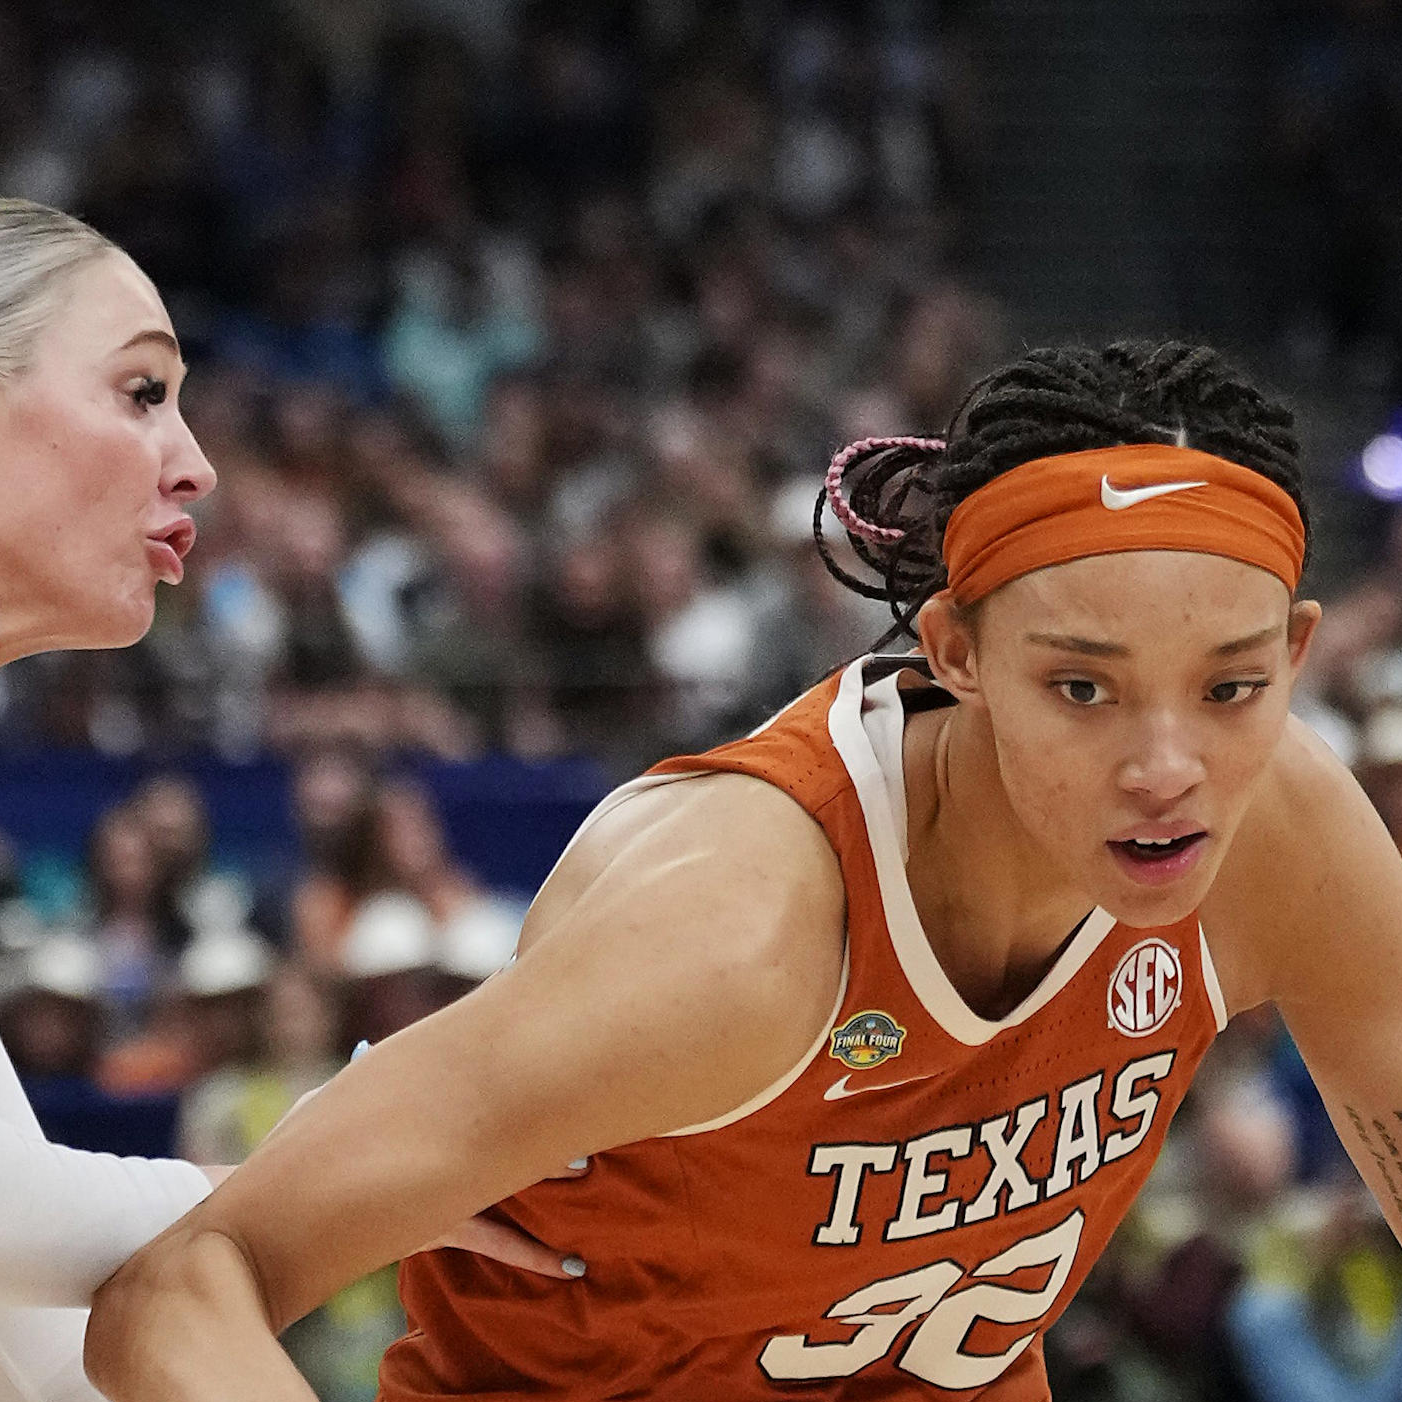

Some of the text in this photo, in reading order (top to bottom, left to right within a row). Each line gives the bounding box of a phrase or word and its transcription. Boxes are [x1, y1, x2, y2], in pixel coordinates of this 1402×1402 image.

[835, 1034, 899, 1049] FINAL FOUR
[1114, 946, 1177, 1031] SEC
[808, 1049, 1178, 1247] TEXAS
[759, 1207, 1086, 1391] 32
